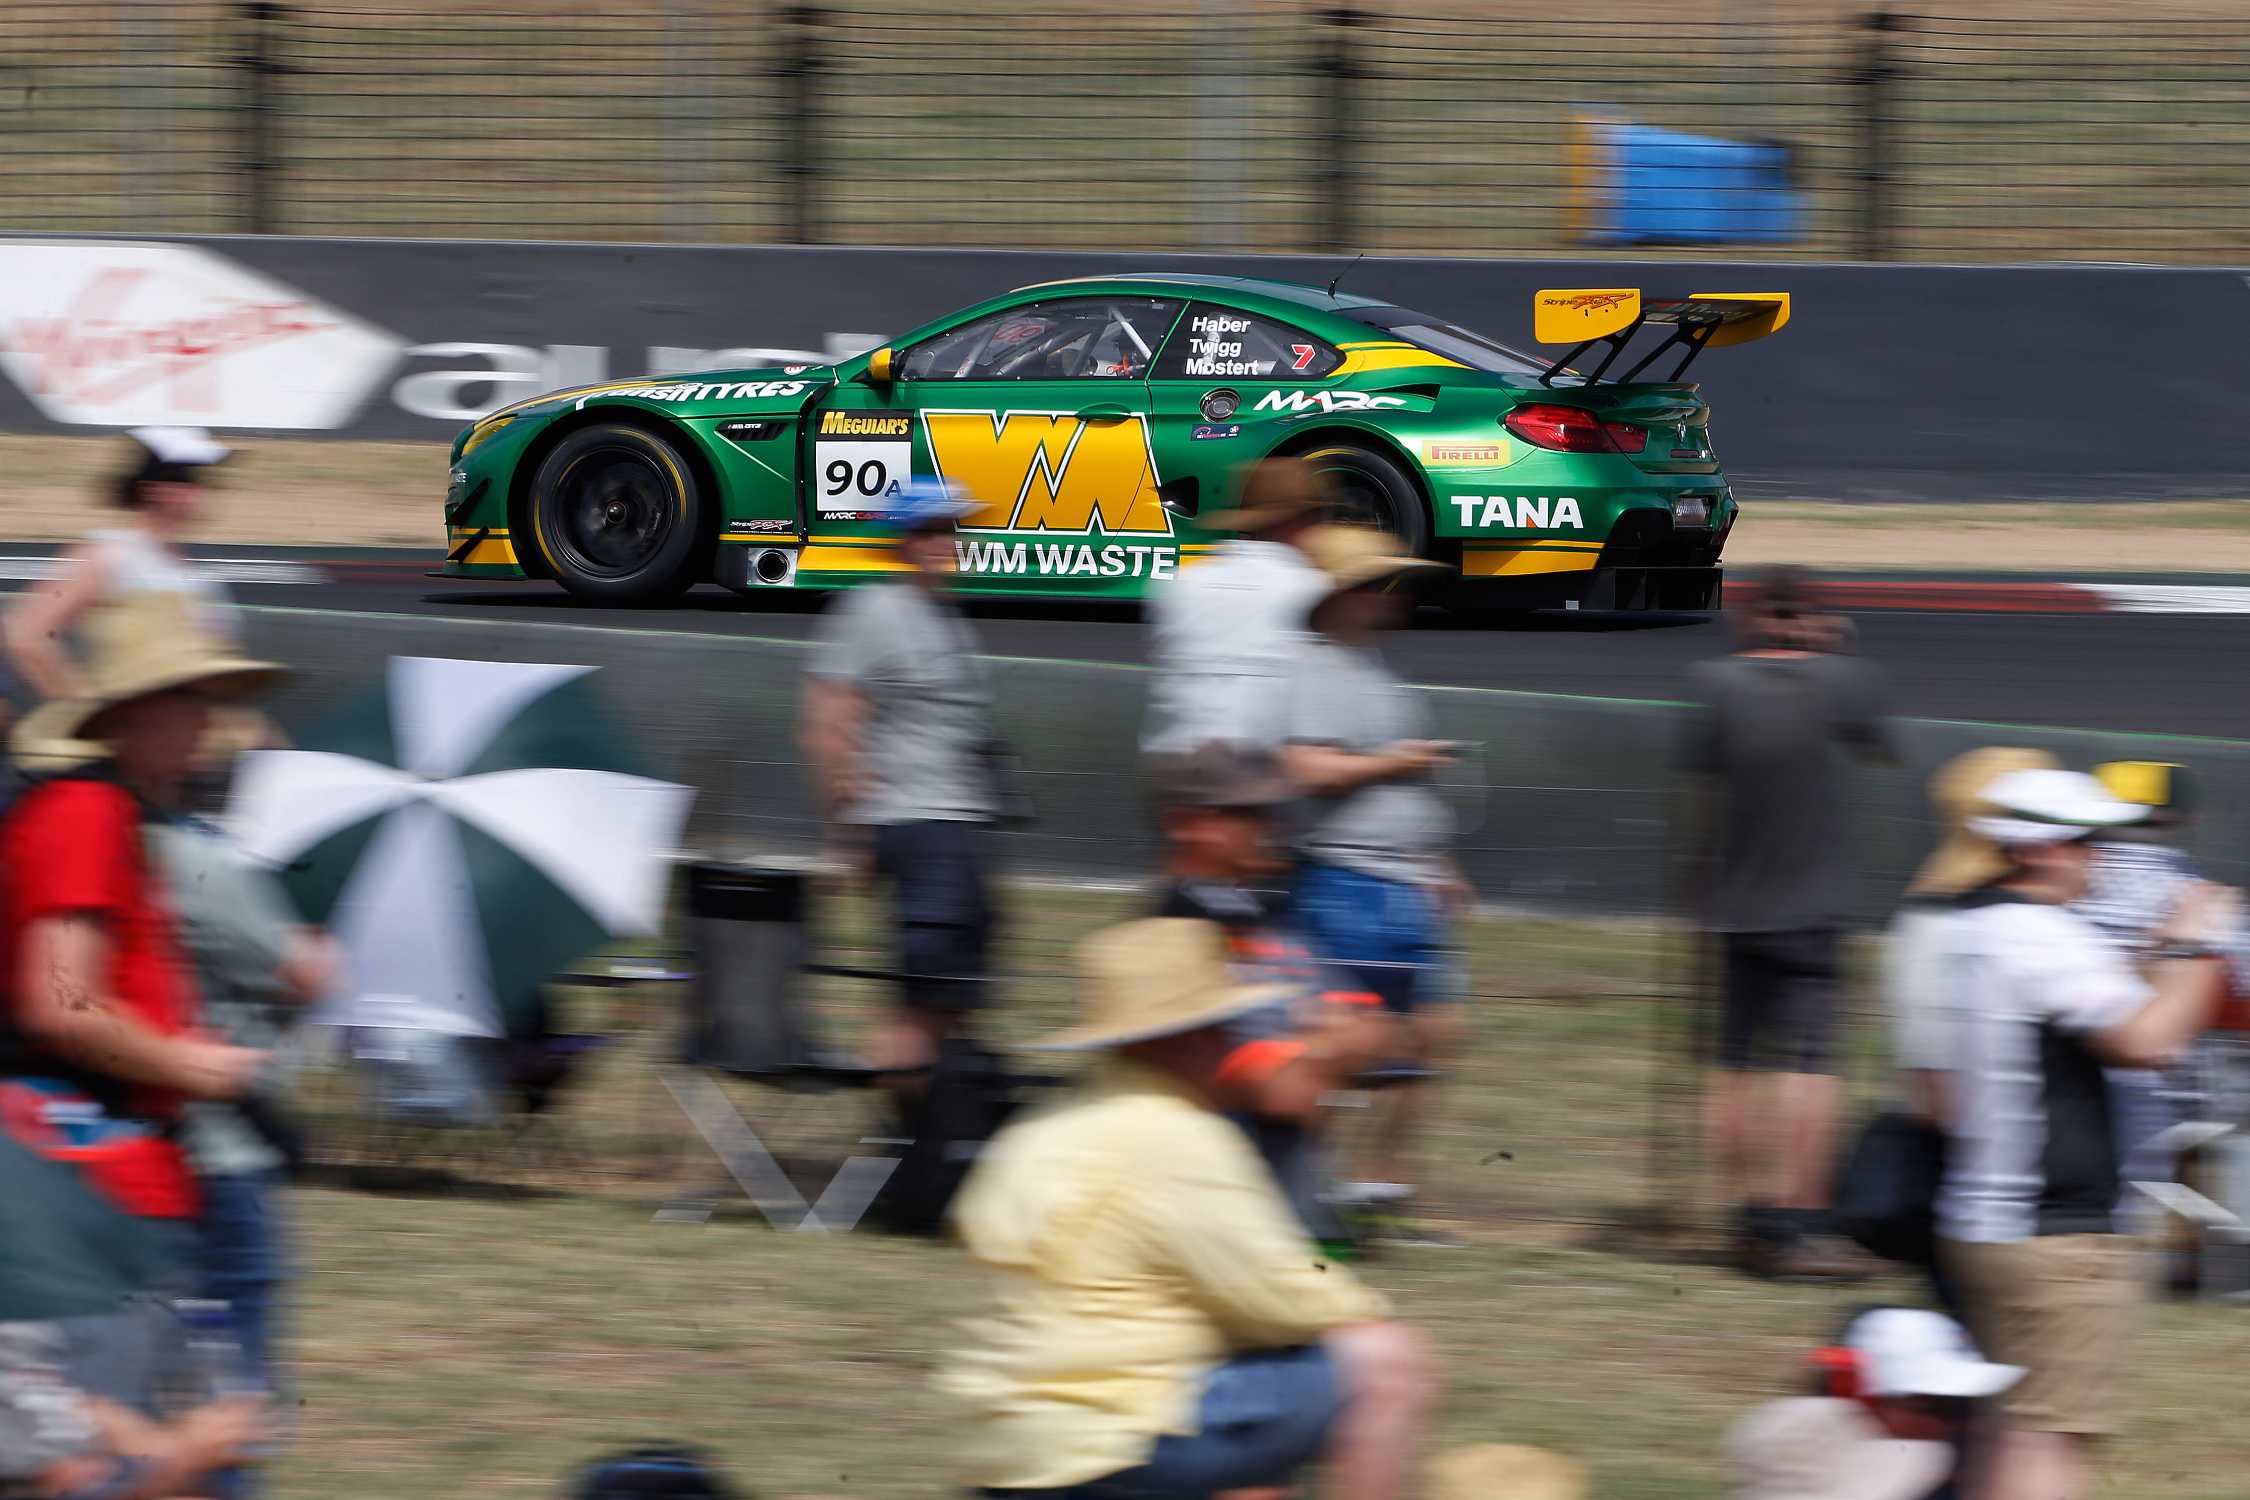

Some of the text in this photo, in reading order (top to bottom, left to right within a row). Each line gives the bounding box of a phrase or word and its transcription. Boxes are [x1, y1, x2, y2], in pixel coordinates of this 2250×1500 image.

[1192, 317, 1251, 332] Haber
[1189, 338, 1242, 357] Twigg
[1291, 344, 1316, 370] 7
[1185, 359, 1259, 375] Mostert
[820, 411, 909, 435] MEGUIAR'S
[1432, 446, 1500, 460] PIRELLI
[1451, 496, 1584, 529] TANA
[954, 540, 1176, 580] WM WASTE
